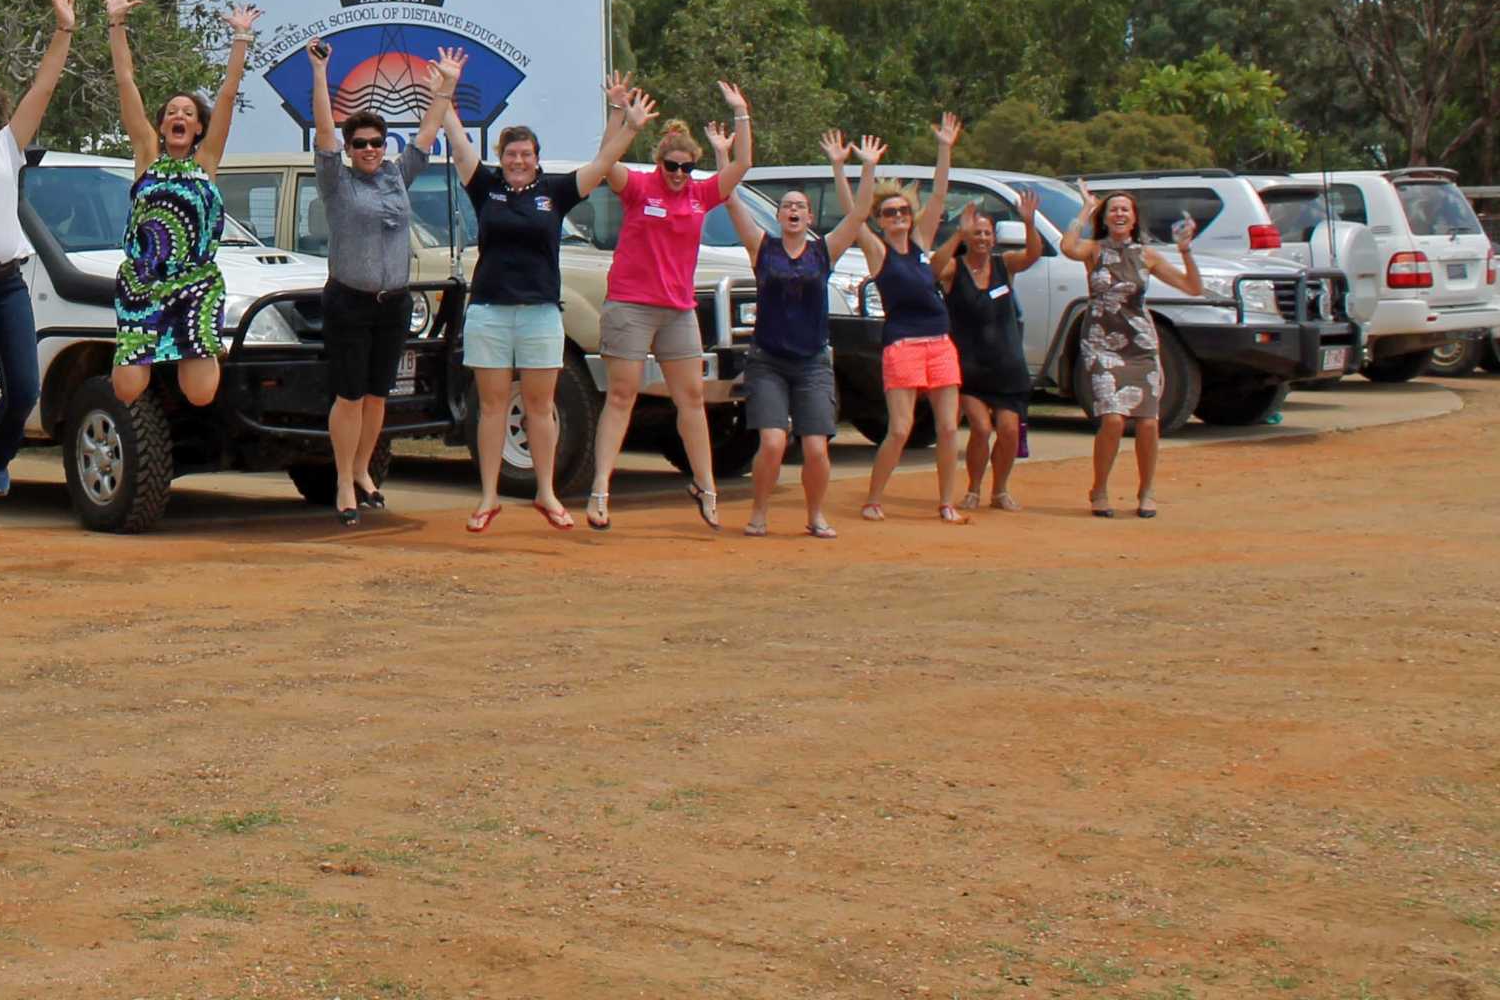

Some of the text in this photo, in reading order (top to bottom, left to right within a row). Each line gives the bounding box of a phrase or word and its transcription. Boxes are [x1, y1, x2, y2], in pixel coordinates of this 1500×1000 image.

[329, 8, 379, 27] SCHOOL
[382, 7, 399, 20] OF
[403, 7, 463, 29] DISTANCE
[463, 20, 531, 68] EDUCATION
